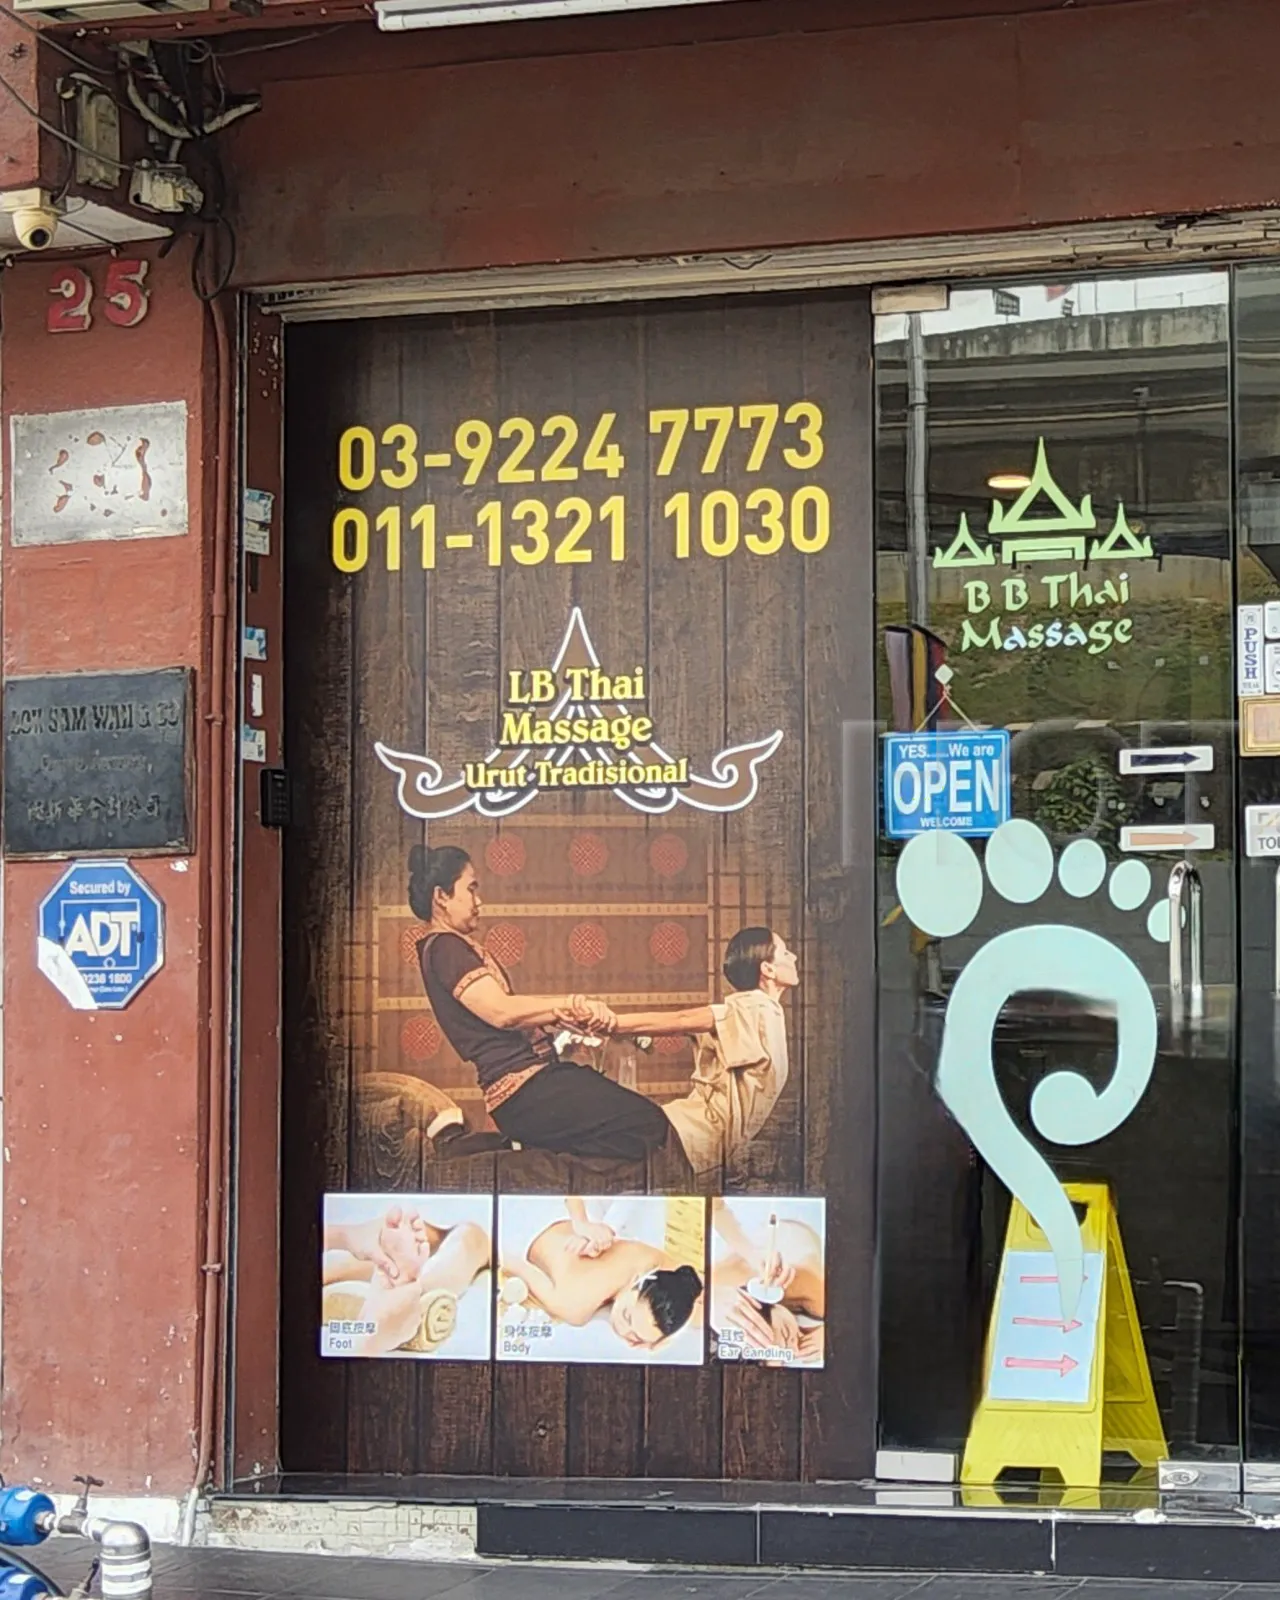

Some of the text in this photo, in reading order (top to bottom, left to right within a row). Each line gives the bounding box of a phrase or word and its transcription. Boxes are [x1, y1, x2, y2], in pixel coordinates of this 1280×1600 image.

[47, 259, 152, 333] 25
[338, 401, 824, 491] 03-9224 7773
[332, 485, 831, 573] 011-1321 1030
[1041, 571, 1130, 609] Thai
[961, 617, 1133, 655] Massage
[1244, 627, 1258, 680] PUSH
[508, 666, 646, 704] LB Thai
[500, 713, 653, 749] Massage
[973, 745, 995, 757] are
[465, 759, 688, 789] Urut Tradisional
[893, 759, 1000, 815] OPEN
[920, 816, 973, 828] WELCOME
[69, 880, 131, 896] Secured by
[65, 910, 139, 957] ADT
[329, 1338, 352, 1349] Foot
[503, 1341, 531, 1355] Body
[720, 1345, 740, 1358] Ear
